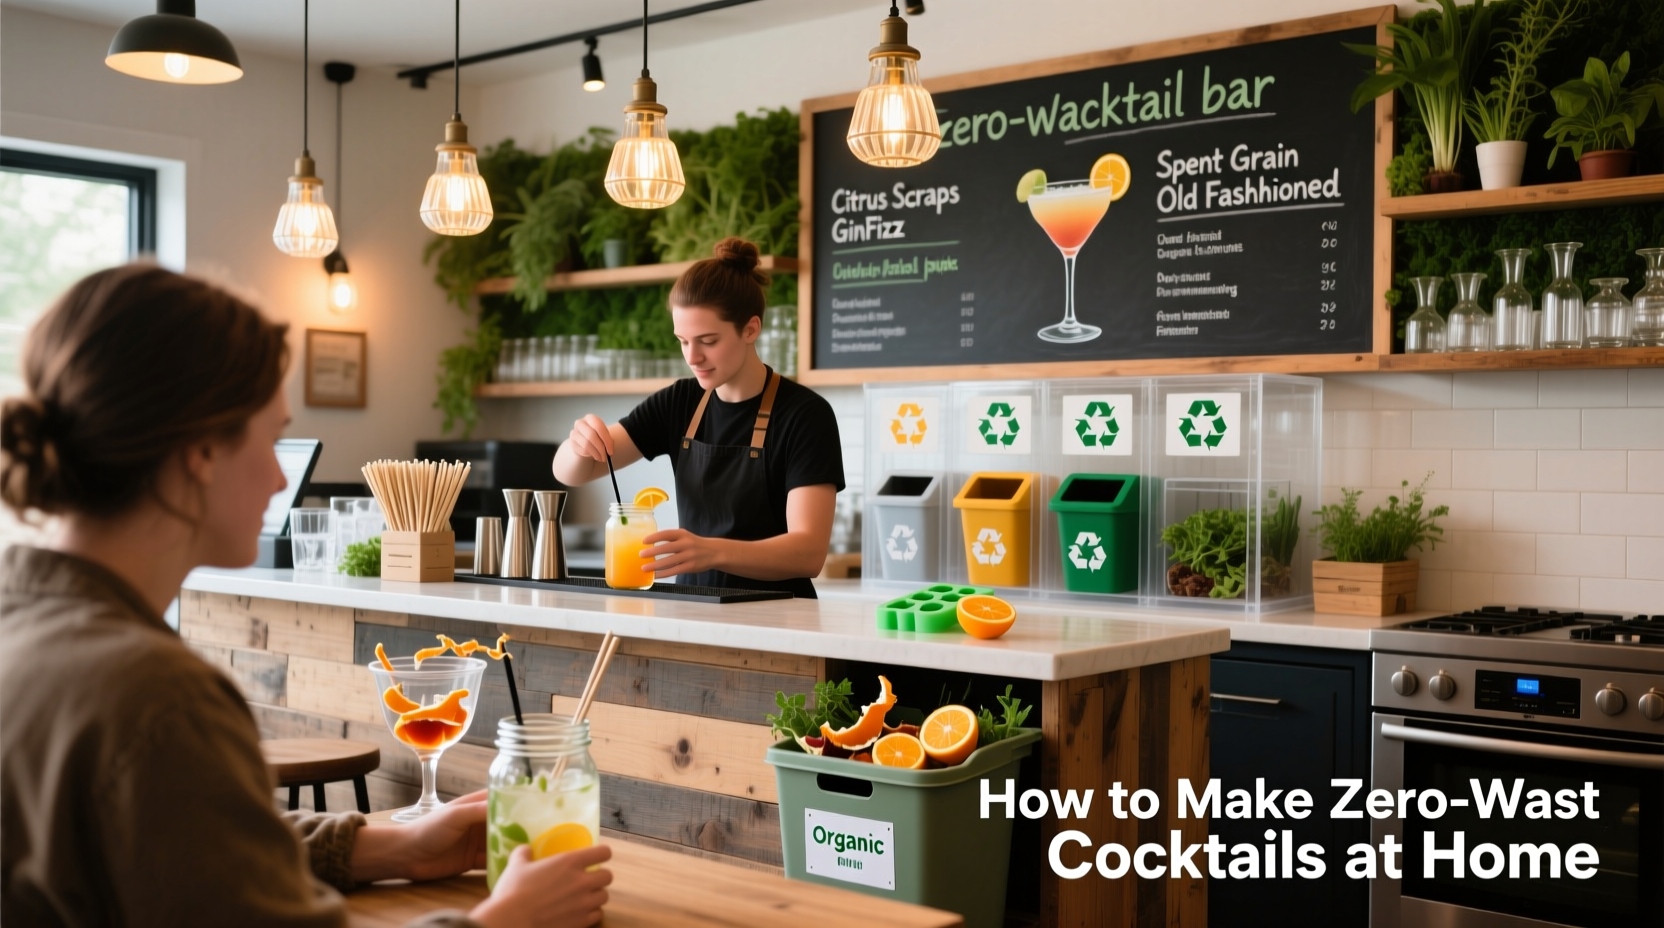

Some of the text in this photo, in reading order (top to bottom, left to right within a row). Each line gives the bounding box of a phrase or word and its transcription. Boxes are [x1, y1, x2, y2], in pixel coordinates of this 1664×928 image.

[1202, 65, 1276, 115] bar
[1156, 143, 1299, 185] Spent Grain
[831, 182, 960, 215] Citrus Scraps
[1157, 167, 1342, 213] Old Fashhioned
[831, 215, 906, 243] GinFizz
[813, 825, 884, 855] Organic
